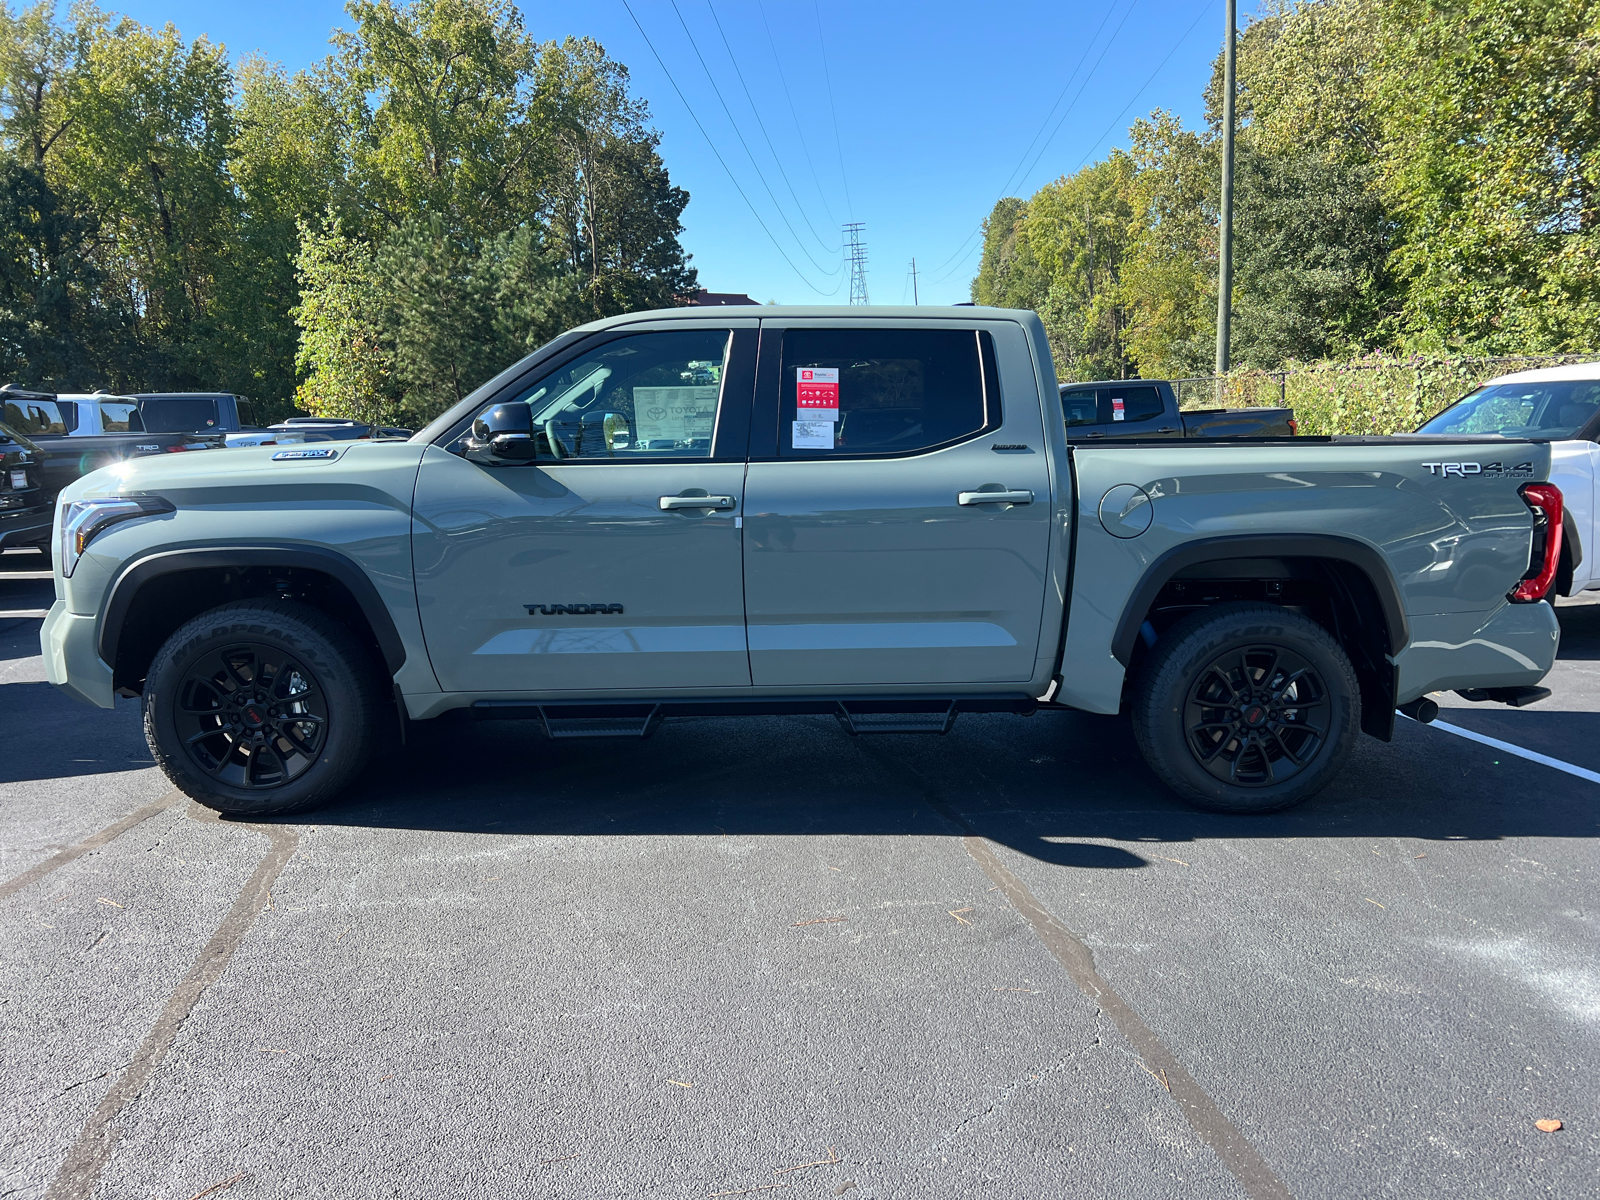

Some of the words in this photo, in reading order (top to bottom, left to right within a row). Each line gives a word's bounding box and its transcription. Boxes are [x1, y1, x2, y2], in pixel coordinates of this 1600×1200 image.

[669, 406, 709, 415] TOYOTA
[1421, 462, 1483, 478] TRD
[522, 603, 624, 616] TUNDRA
[172, 624, 303, 667] WILDPEAK
